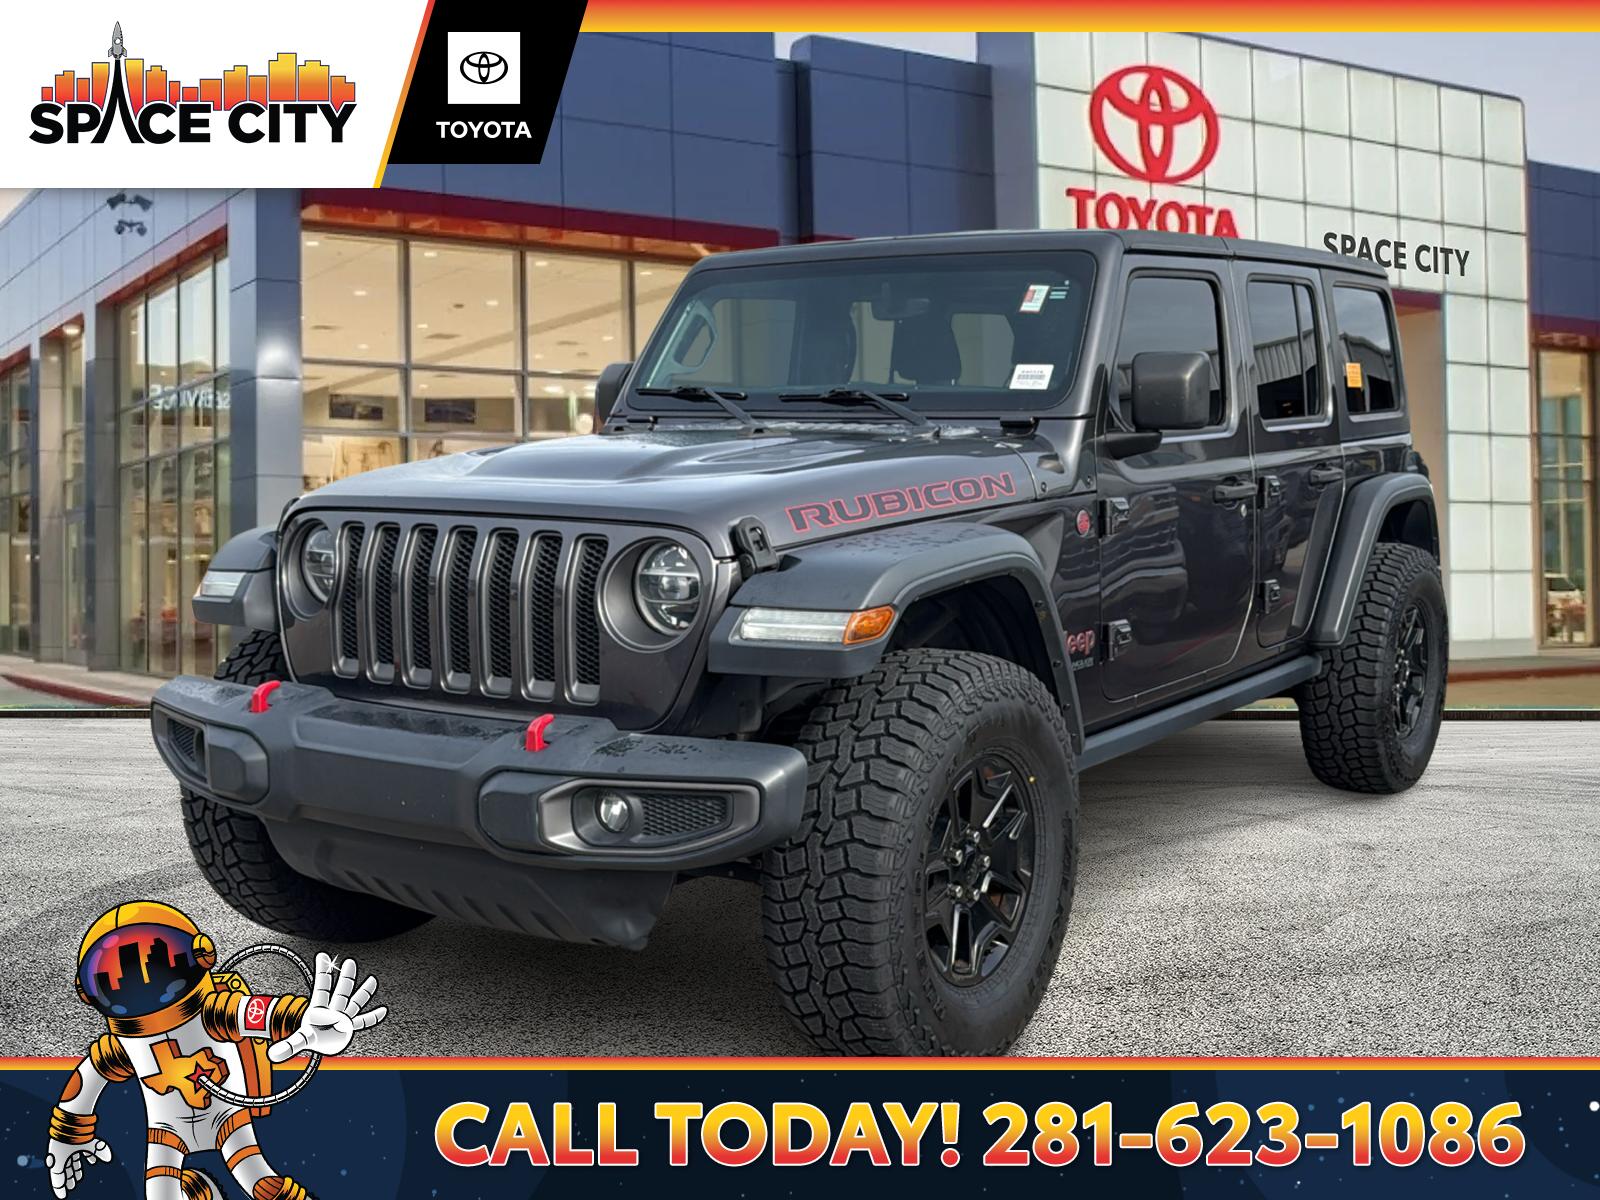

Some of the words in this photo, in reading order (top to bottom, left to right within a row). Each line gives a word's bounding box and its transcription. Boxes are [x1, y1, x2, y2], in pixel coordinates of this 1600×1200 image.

[1066, 188, 1239, 238] TOYOTA
[1323, 232, 1407, 270] SPACE
[1415, 244, 1470, 276] CITY
[785, 472, 1016, 534] RUBICON
